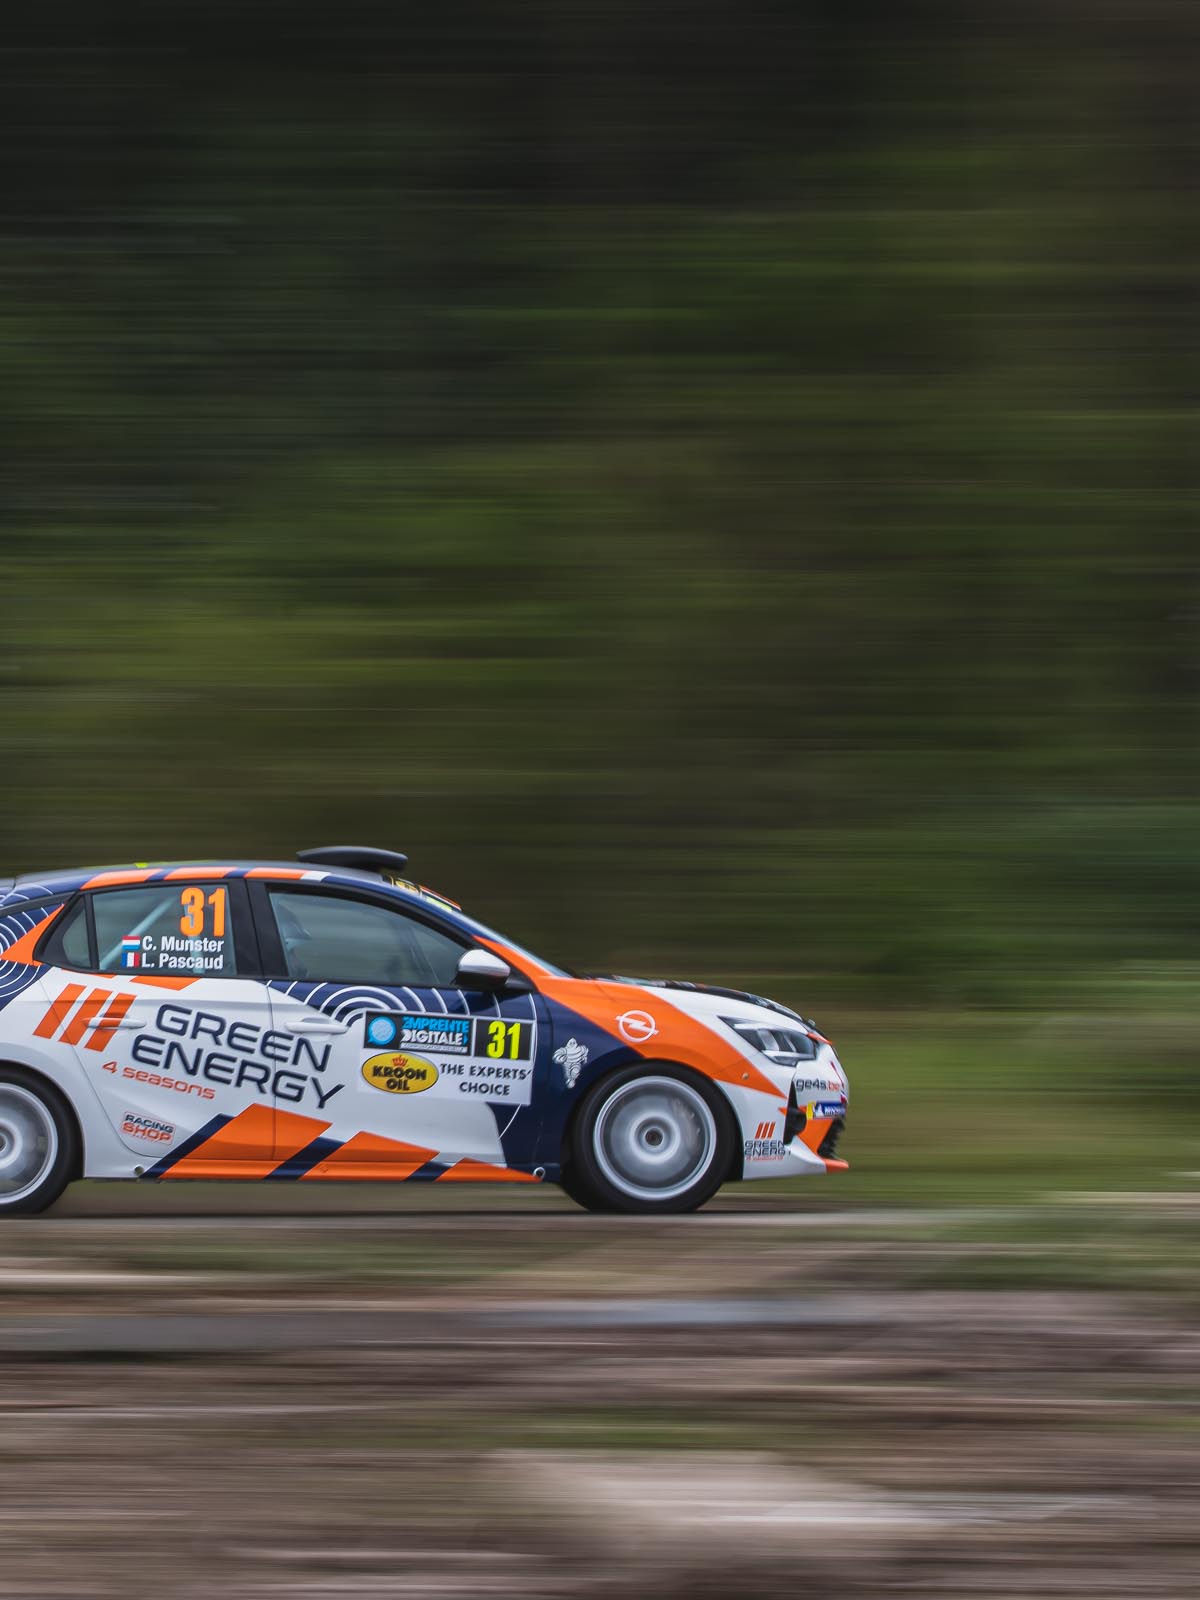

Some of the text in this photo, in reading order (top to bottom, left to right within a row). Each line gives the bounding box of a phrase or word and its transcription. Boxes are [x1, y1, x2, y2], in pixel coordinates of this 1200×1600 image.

[180, 887, 225, 937] 31
[142, 935, 225, 952] C. Munster
[141, 952, 224, 969] L. Pascaud
[156, 1003, 332, 1072] GREEN
[401, 1028, 463, 1046] DIGITALE
[487, 1020, 521, 1060] 31
[131, 1033, 345, 1109] ENERGY
[372, 1065, 427, 1081] KROON
[440, 1063, 532, 1080] THE EXPERTS'
[102, 1061, 216, 1100] 4 seasons
[386, 1078, 410, 1091] OIL
[459, 1082, 511, 1096] CHOICE
[122, 1122, 171, 1141] SHOP
[125, 1114, 174, 1133] RACING
[744, 1140, 785, 1149] GREEN
[744, 1147, 791, 1157] ENERG
